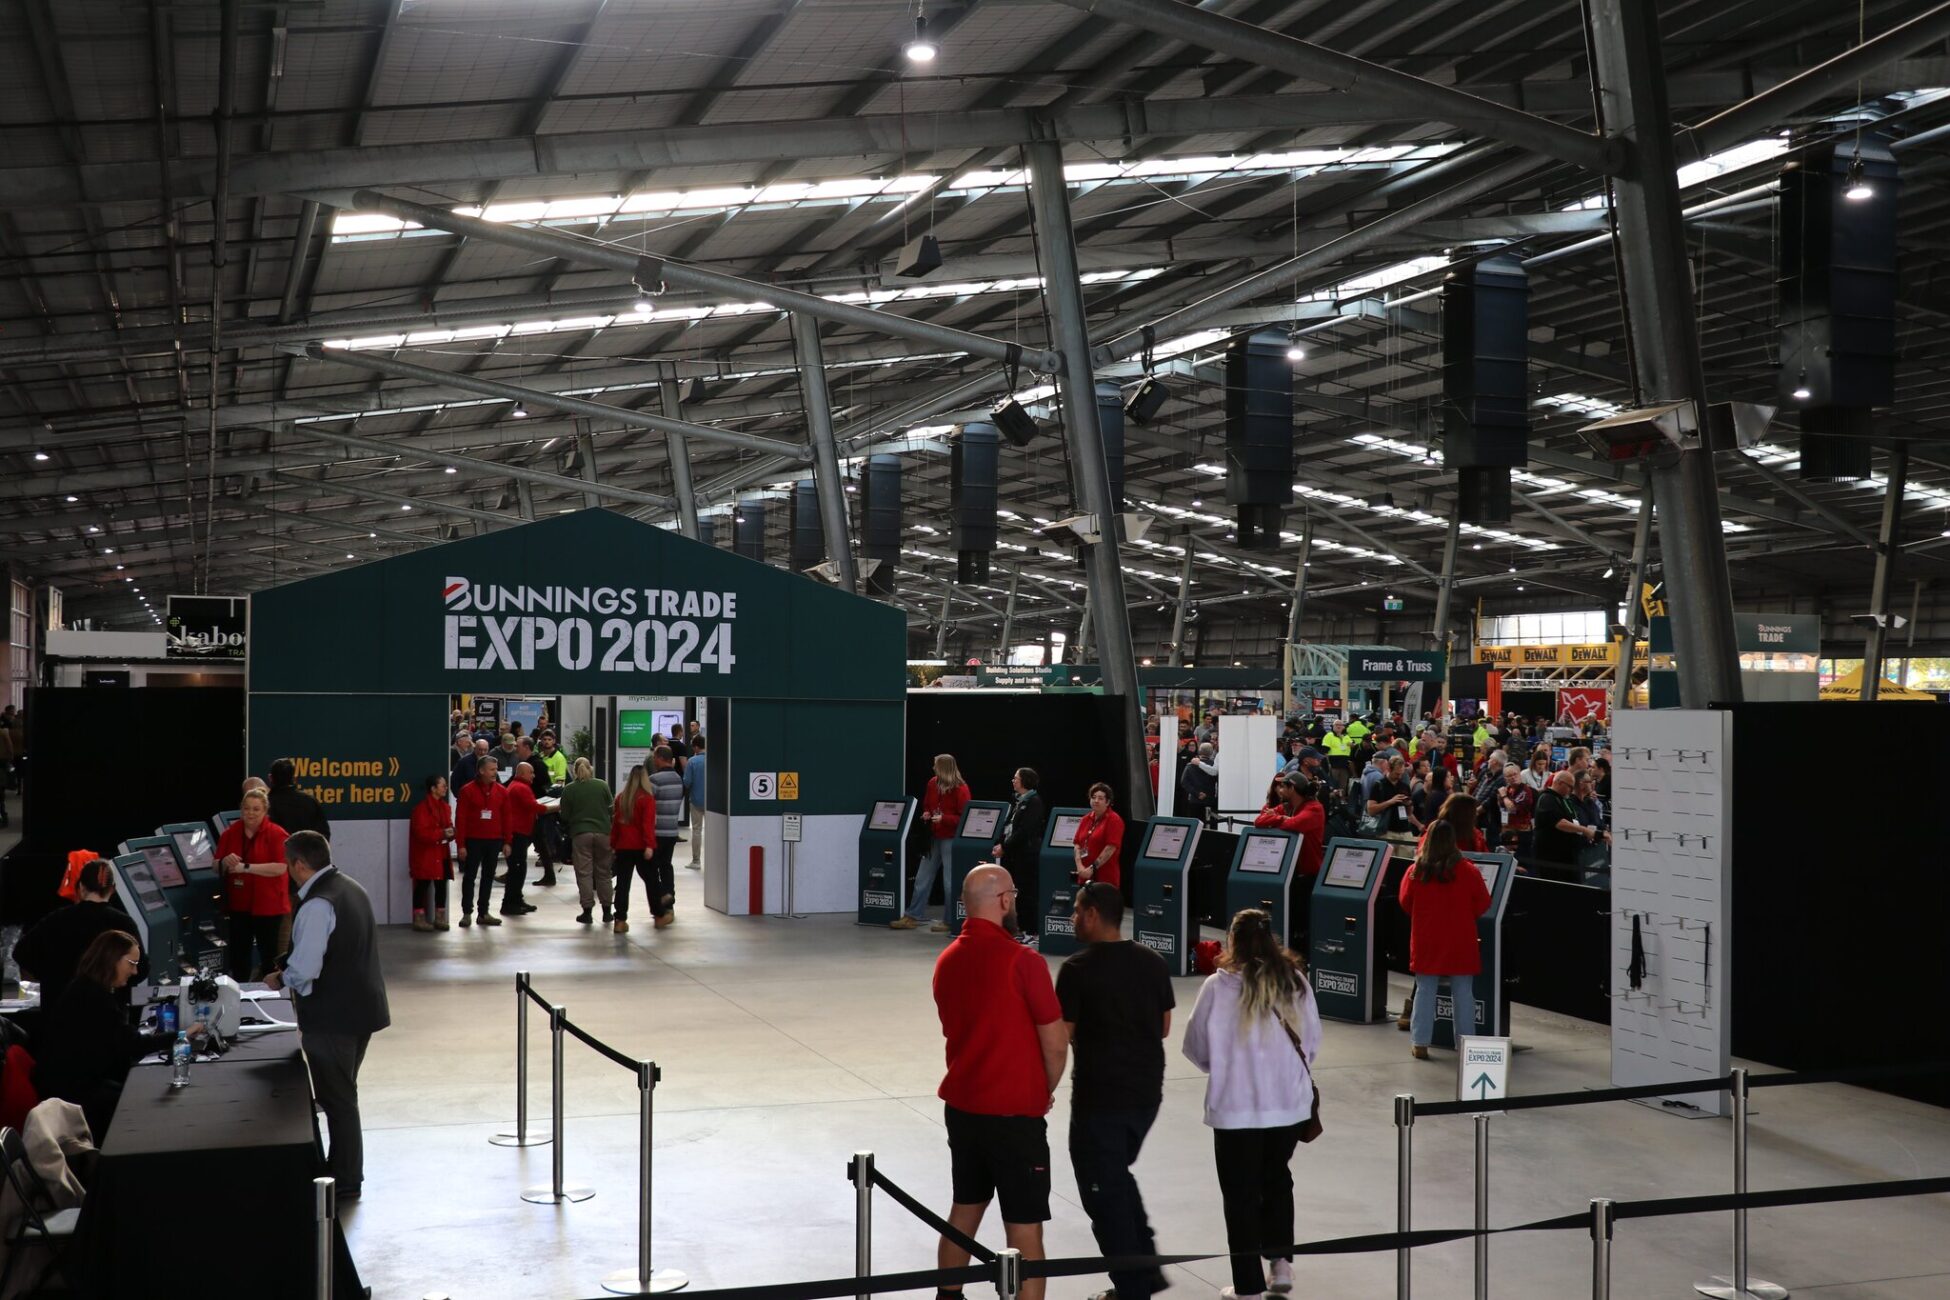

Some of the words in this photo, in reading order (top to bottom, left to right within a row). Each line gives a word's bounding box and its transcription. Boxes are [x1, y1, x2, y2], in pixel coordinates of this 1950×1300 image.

[443, 576, 638, 615] BUNNINGS
[644, 589, 737, 618] TRADE
[180, 625, 246, 646] kabo
[1758, 632, 1785, 643] TRADE
[444, 615, 593, 670] EXPO
[600, 618, 736, 674] 2024
[985, 666, 1008, 675] Building
[1009, 666, 1034, 674] Solutions
[1035, 666, 1052, 674] Studio
[1362, 659, 1393, 672] Frame
[1395, 659, 1404, 672] &
[1406, 660, 1432, 672] Truss
[995, 676, 1014, 685] Supply
[288, 757, 383, 777] Welcome
[757, 778, 769, 793] 5
[350, 783, 395, 803] here
[1047, 923, 1064, 932] EXPO
[1318, 978, 1337, 990] EXPO
[1336, 981, 1355, 993] 2024
[1437, 1006, 1453, 1017] EXP
[1468, 1054, 1485, 1062] EXPO
[1485, 1054, 1502, 1063] 2024
